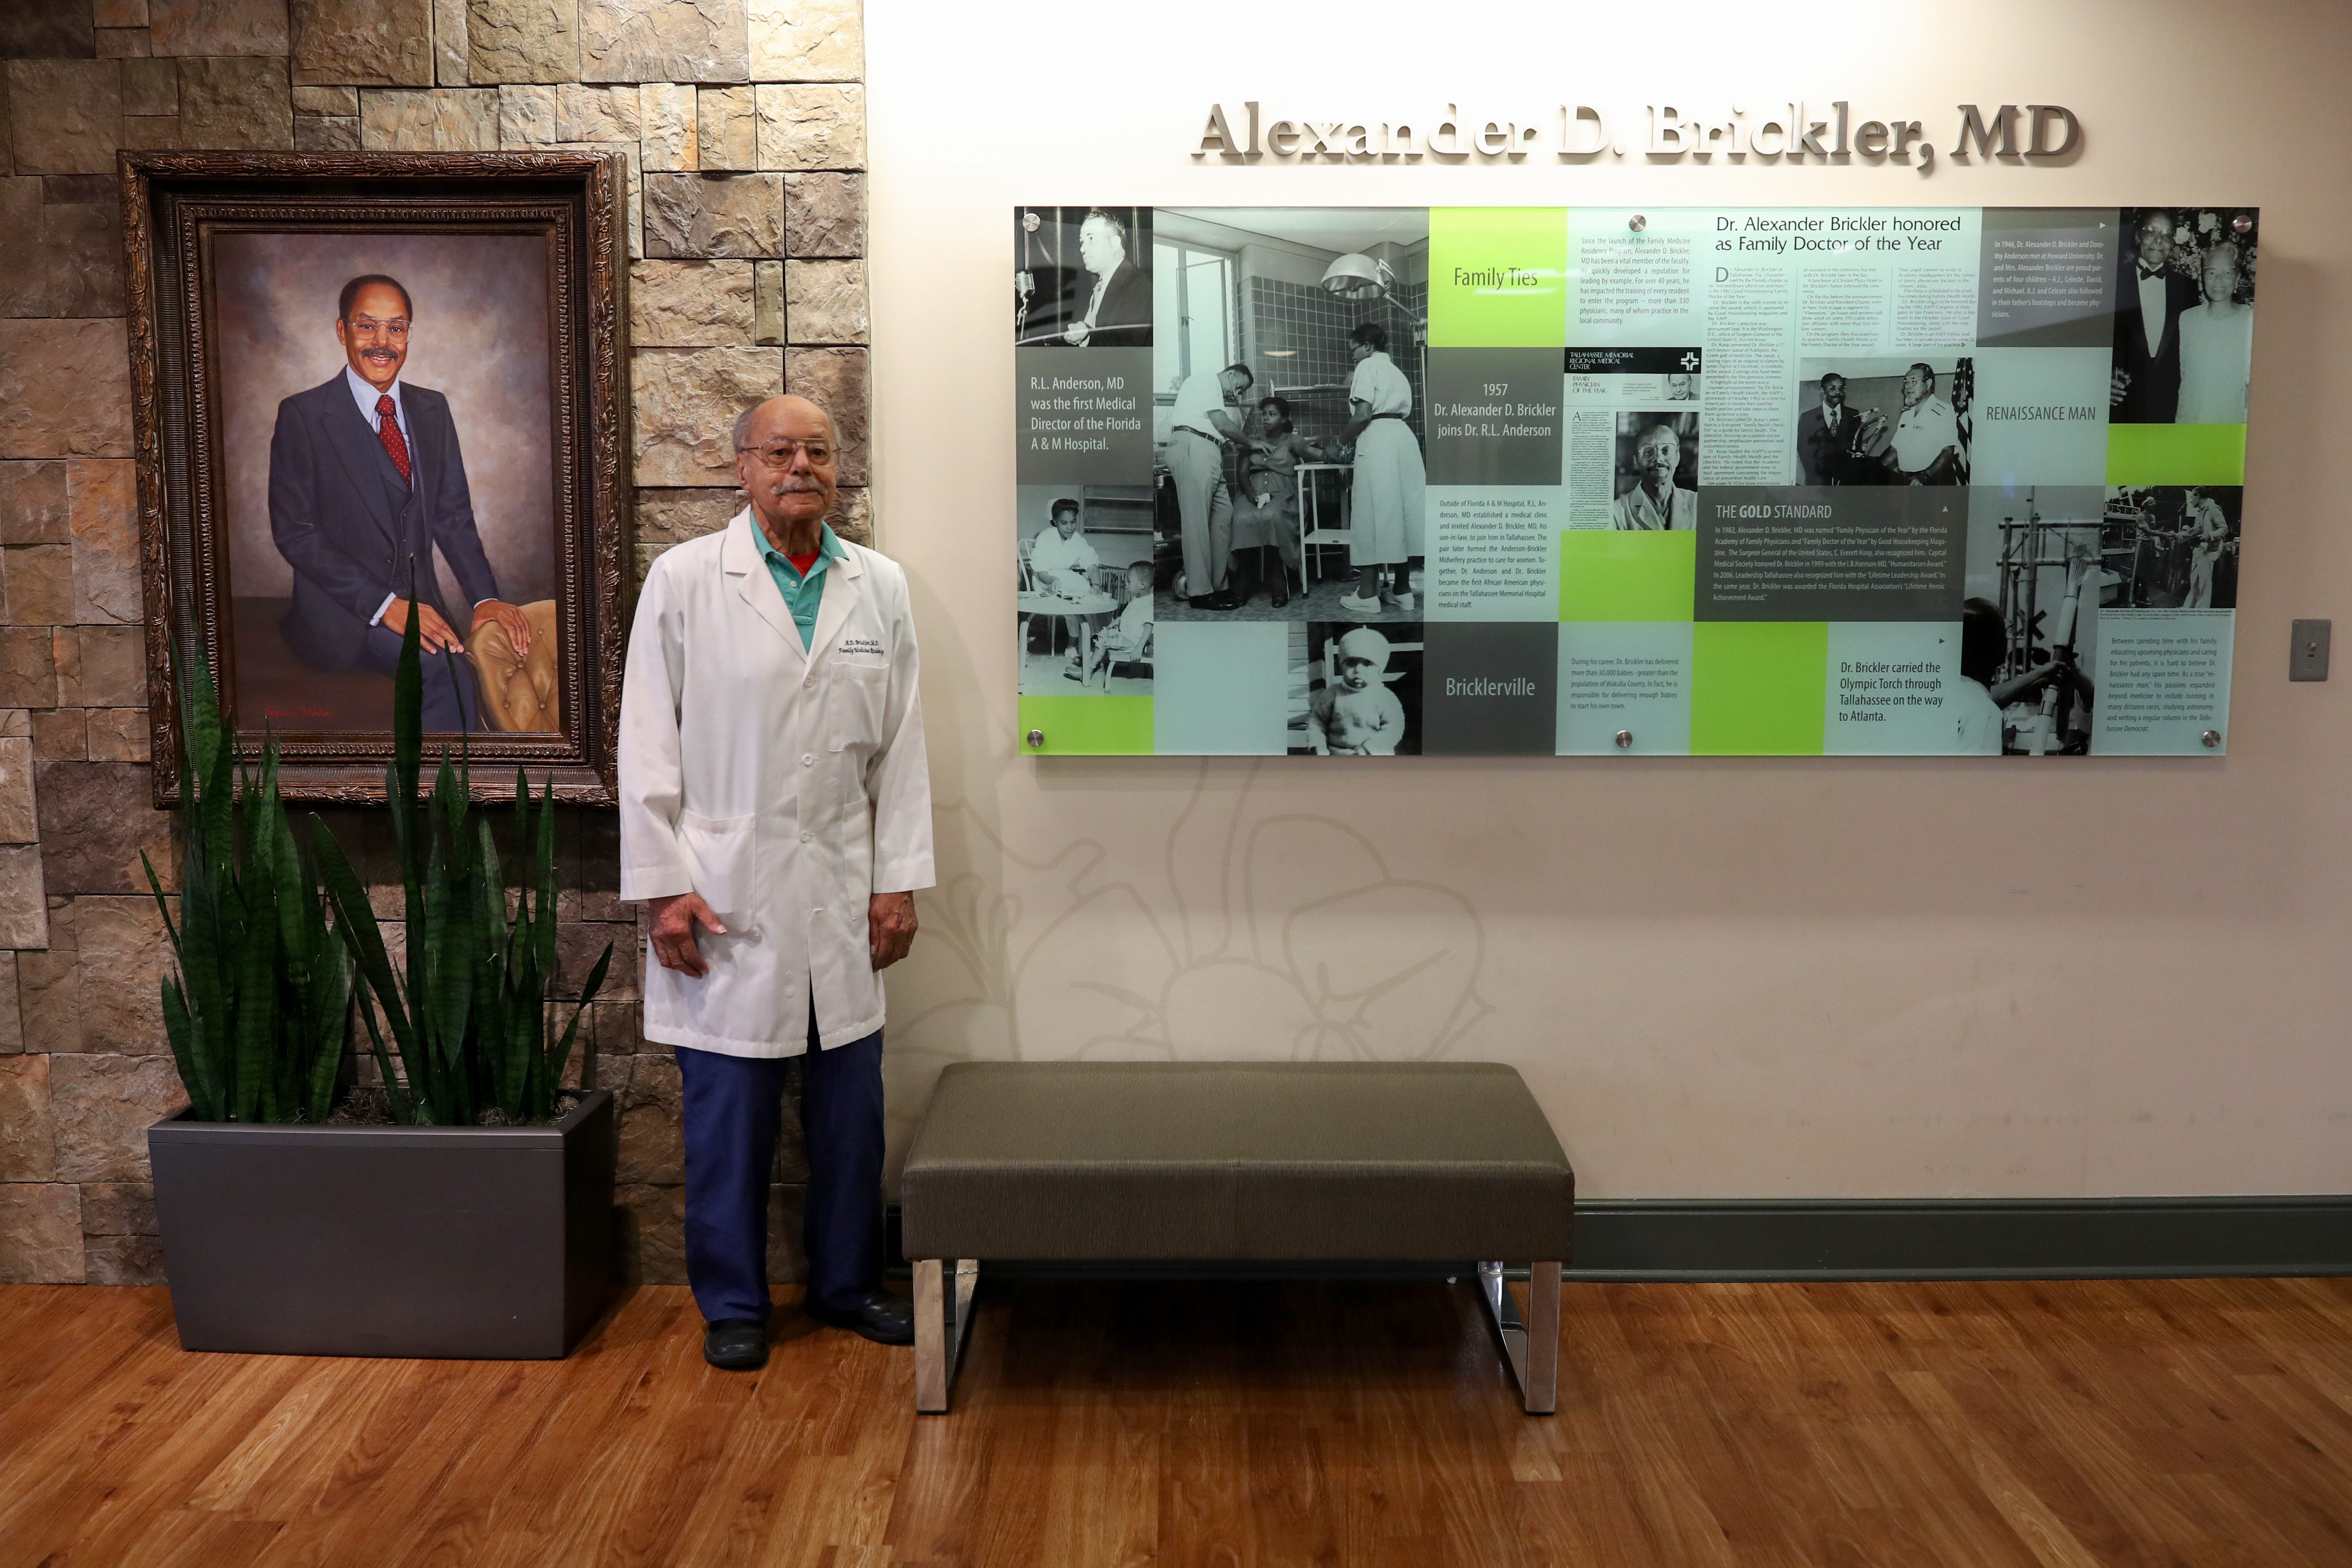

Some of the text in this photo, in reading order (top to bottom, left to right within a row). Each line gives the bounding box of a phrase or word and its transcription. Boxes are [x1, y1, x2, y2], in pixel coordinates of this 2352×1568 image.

[1191, 101, 2080, 170] Alexander D. Brickler, MD
[1717, 217, 1960, 231] Dr. Alexander Brickler honored
[1648, 237, 1665, 245] Family
[1715, 236, 1942, 254] as Family Doctor of the Year
[1581, 247, 1608, 255] Residency
[1609, 248, 1633, 256] Program,
[1994, 252, 2003, 261] thy
[2069, 252, 2096, 261] University.
[1455, 267, 1537, 290] Family Ties
[1031, 377, 1124, 392] R.L. Anderson, MD
[1483, 384, 1508, 395] 1957
[1031, 397, 1135, 410] was the first Medical
[1435, 403, 1556, 416] Dr. Alexander D. Brickler
[1987, 407, 2095, 420] RENAISSANCE MAN
[1032, 417, 1140, 430] Director of the Florida
[1437, 423, 1550, 439] joins Dr. R.L. Anderson
[1031, 437, 1109, 453] A & M Hospital.
[1504, 500, 1526, 508] Hospital,
[1716, 505, 1831, 518] THE GOLD STANDARD
[1855, 527, 1879, 535] Physician
[1912, 527, 1918, 535] by
[2136, 637, 2160, 646] spending
[2200, 637, 2217, 646] family,
[1572, 658, 1589, 666] During
[1841, 662, 1940, 673] Dr. Brickler carried the
[1446, 677, 1535, 695] Bricklerville
[1840, 678, 1941, 692] Olympic Torch through
[1840, 694, 1891, 705] Tallahassee
[1907, 694, 1922, 705] the
[1924, 697, 1943, 708] way
[1839, 710, 1886, 721] to Atlanta.
